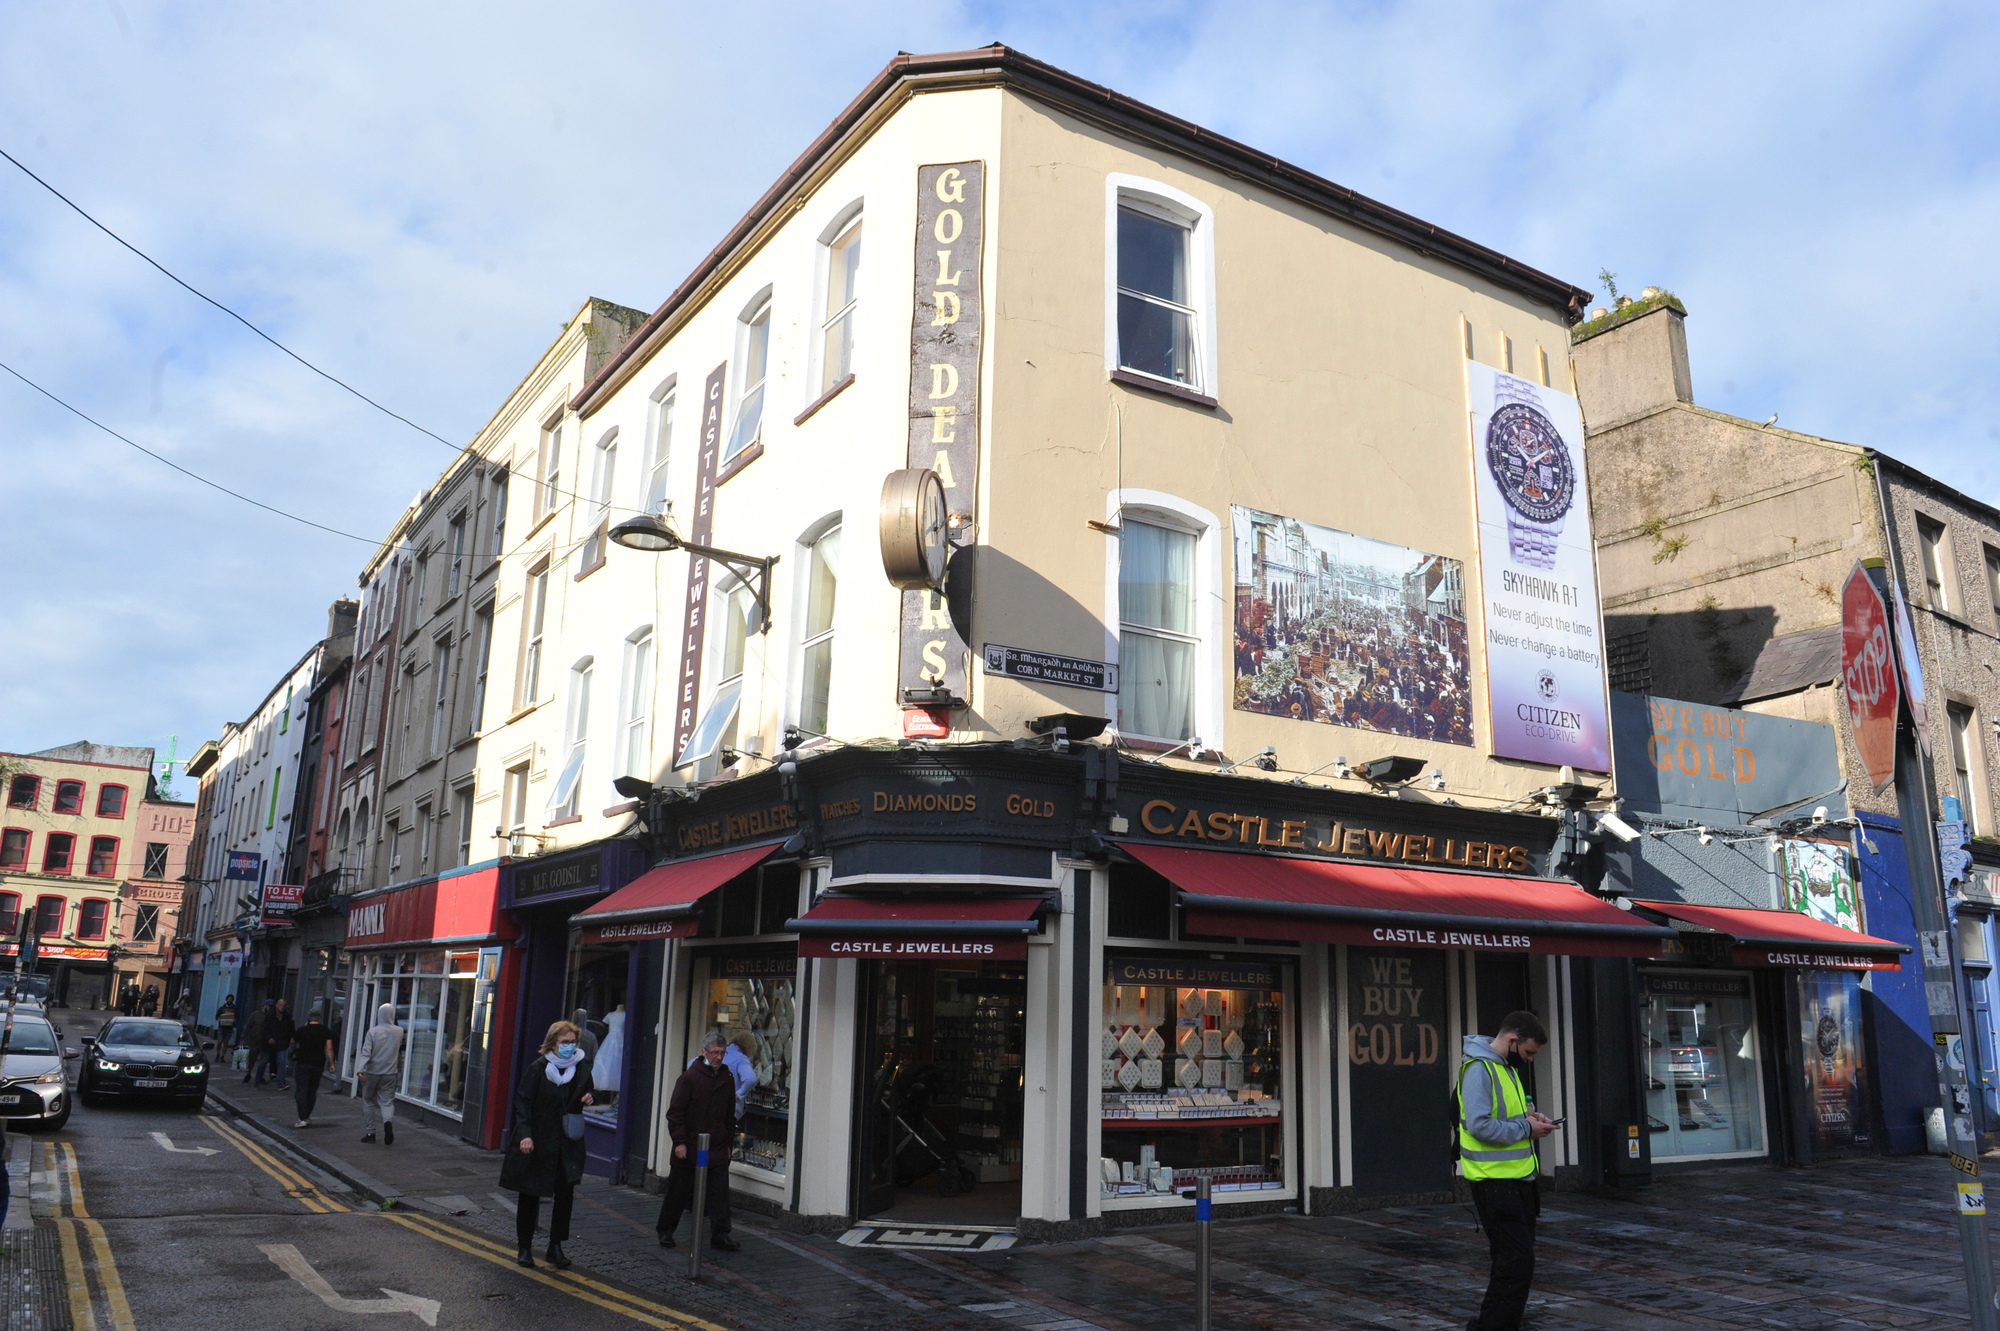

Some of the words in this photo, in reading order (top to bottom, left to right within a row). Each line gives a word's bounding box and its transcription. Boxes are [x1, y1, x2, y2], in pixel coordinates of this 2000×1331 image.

[931, 167, 967, 326] GOLD
[700, 381, 719, 517] CASTLE
[919, 363, 960, 682] DEARS
[1503, 570, 1559, 603] SKYHAWK
[1493, 602, 1522, 622] Never
[1525, 610, 1553, 629] adjust
[1555, 615, 1571, 632] the
[1572, 620, 1593, 637] time
[1489, 629, 1519, 648] Never
[1521, 636, 1557, 659] change
[1559, 646, 1565, 657] a
[1567, 645, 1600, 669] battery
[1017, 664, 1039, 676] CORN
[1043, 667, 1081, 682] MARKET
[1084, 676, 1095, 685] ST.
[1108, 672, 1113, 685] 1
[1847, 623, 1888, 728] STOP
[1517, 703, 1581, 730] CITIZEN
[1649, 702, 1694, 733] WE
[1702, 710, 1747, 741] BUY
[1525, 723, 1577, 743] ECO-DRIVE
[1647, 734, 1756, 782] GOLD
[820, 799, 861, 820] WATCHES
[873, 792, 977, 812] DIAMONDS
[1007, 794, 1055, 818] GOLD
[151, 814, 193, 834] HOS
[677, 820, 723, 851] CASTLE
[724, 804, 799, 841] JEWELLERS
[1140, 799, 1307, 850] CASTLE
[1317, 820, 1529, 872] JEWELLERS
[230, 858, 258, 869] popsicle
[550, 865, 582, 887] GODSIL
[138, 888, 183, 900] GROCE
[267, 886, 280, 895] TO
[282, 887, 302, 896] LET
[600, 923, 627, 938] CASTLE
[627, 921, 673, 936] JEWELLERS
[1373, 928, 1437, 945] CASTLE
[1440, 931, 1531, 948] JEWELLERS
[831, 942, 892, 953] CASTLE
[896, 943, 994, 954] JEWELLERS
[726, 958, 763, 973] CASTLE
[764, 957, 798, 972] JEWEL
[1370, 956, 1412, 985] WE
[1767, 953, 1811, 965] CASTLE
[1813, 954, 1874, 968] JEWELLERS
[1124, 965, 1184, 980] CASTLE
[1188, 968, 1274, 985] JEWELLERS
[1653, 979, 1690, 990] CASTLE
[1692, 980, 1745, 992] JEWELLERS
[1363, 987, 1424, 1017] BUY
[1349, 1022, 1439, 1066] GOLD
[1821, 1113, 1846, 1123] CITIZEN
